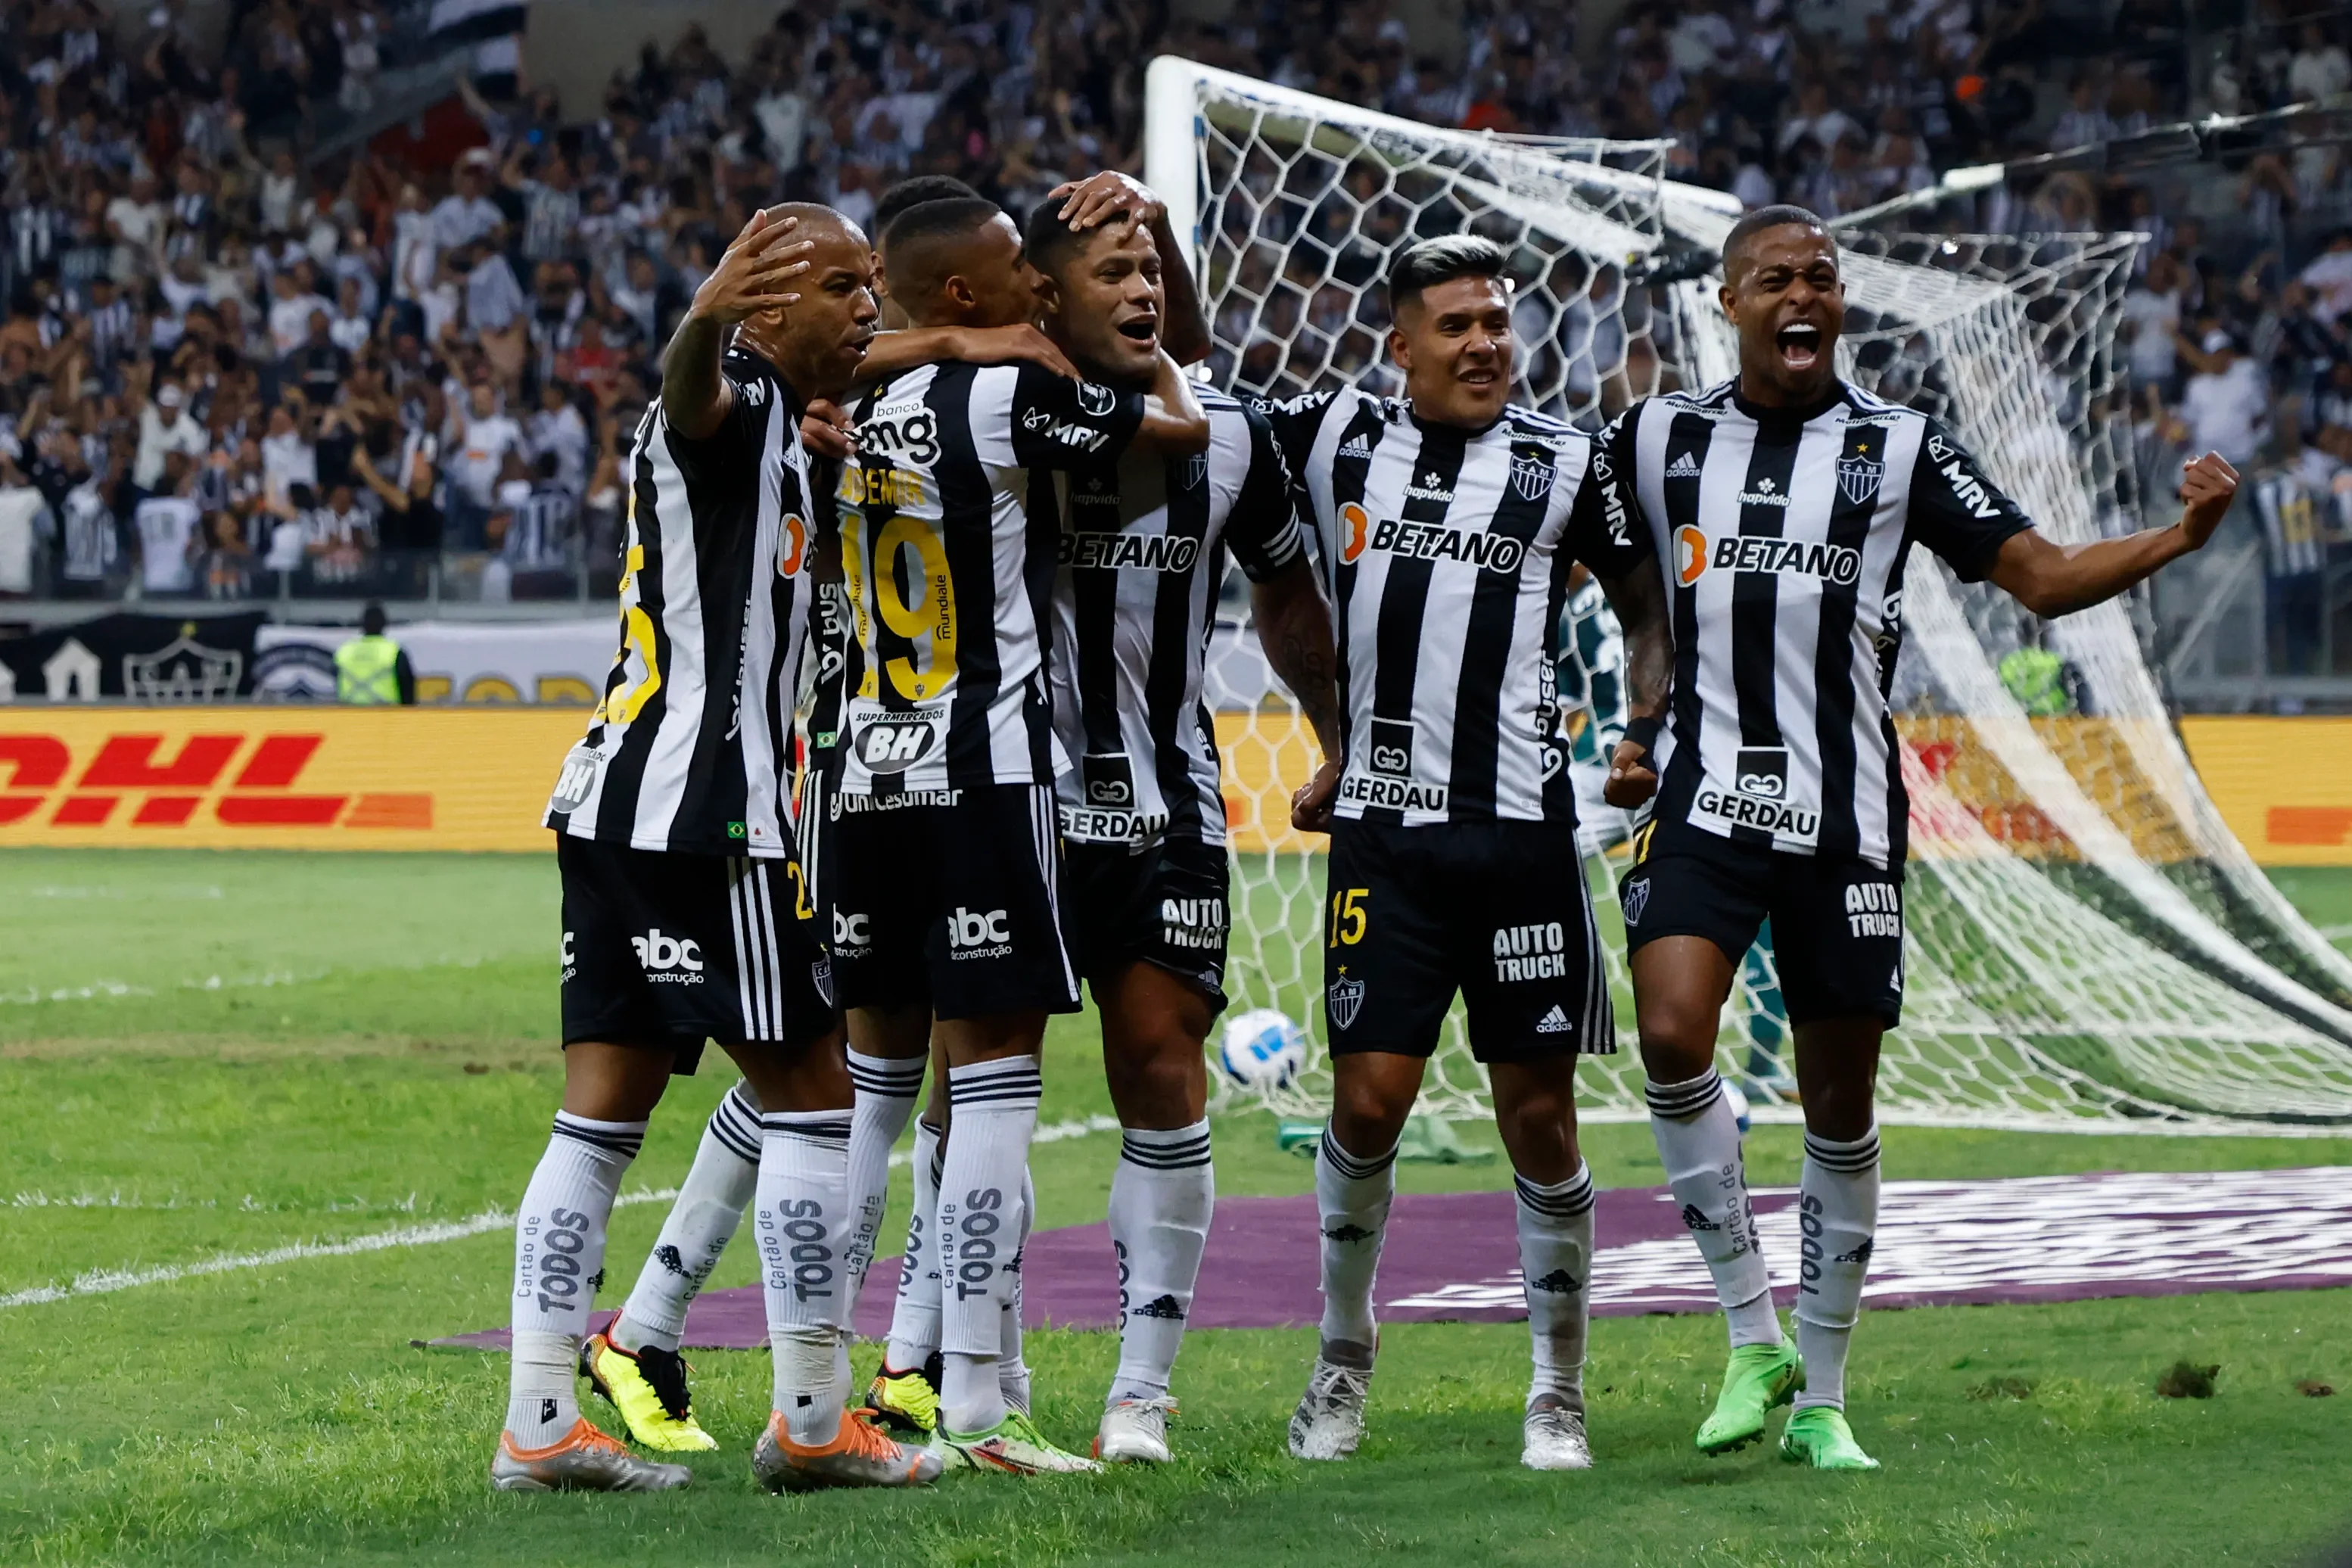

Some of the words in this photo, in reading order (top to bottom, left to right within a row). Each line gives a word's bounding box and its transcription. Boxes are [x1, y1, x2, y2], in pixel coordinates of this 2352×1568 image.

[742, 377, 766, 406] RV
[1273, 390, 1336, 415] MRV
[1666, 400, 1728, 415] Multimarcas
[876, 402, 919, 417] banco
[1835, 414, 1901, 425] Multimarcas
[1044, 417, 1110, 453] MRV
[1339, 446, 1372, 459] adidas
[1843, 463, 1877, 475] CAM
[1517, 462, 1549, 479] CAM
[1666, 467, 1701, 478] adidas
[1403, 483, 1454, 502] hapvida
[1738, 490, 1790, 506] hapvida
[1941, 461, 2001, 519] MRV
[1601, 481, 1633, 546] MRV
[1057, 531, 1199, 574] BETANO
[1370, 519, 1523, 573] BETANO
[1713, 537, 1862, 585] BETANO
[935, 574, 952, 641] mundiale
[1535, 650, 1556, 736] buser
[856, 709, 944, 723] SUPERMERCADOS
[864, 724, 930, 764] BH
[553, 763, 595, 803] BH
[1341, 776, 1445, 812] GERDAU
[1059, 808, 1169, 842] GERDAU
[1697, 789, 1818, 837] GERDAU
[1162, 898, 1223, 928] AUTO
[1846, 882, 1899, 914] AUTO
[947, 907, 1010, 949] abc
[1329, 888, 1370, 949] 15
[1848, 913, 1900, 938] TRUCK
[630, 928, 704, 972] abc
[1164, 926, 1225, 950] TRUCK
[1493, 921, 1564, 957] AUTO
[1493, 953, 1566, 982] TRUCK
[1333, 987, 1357, 999] CAM
[1535, 1020, 1573, 1034] adidas
[1719, 1162, 1737, 1190] de
[523, 1215, 541, 1237] de
[758, 1209, 775, 1231] de
[940, 1203, 957, 1226] de
[708, 1237, 730, 1254] de
[779, 1199, 833, 1303] TODOS
[957, 1187, 1003, 1302] TODOS
[1800, 1190, 1824, 1296] TODOS
[517, 1241, 535, 1298] Cartão
[537, 1207, 590, 1314] TODOS
[763, 1238, 786, 1290] Cartão
[942, 1233, 956, 1289] Cartão
